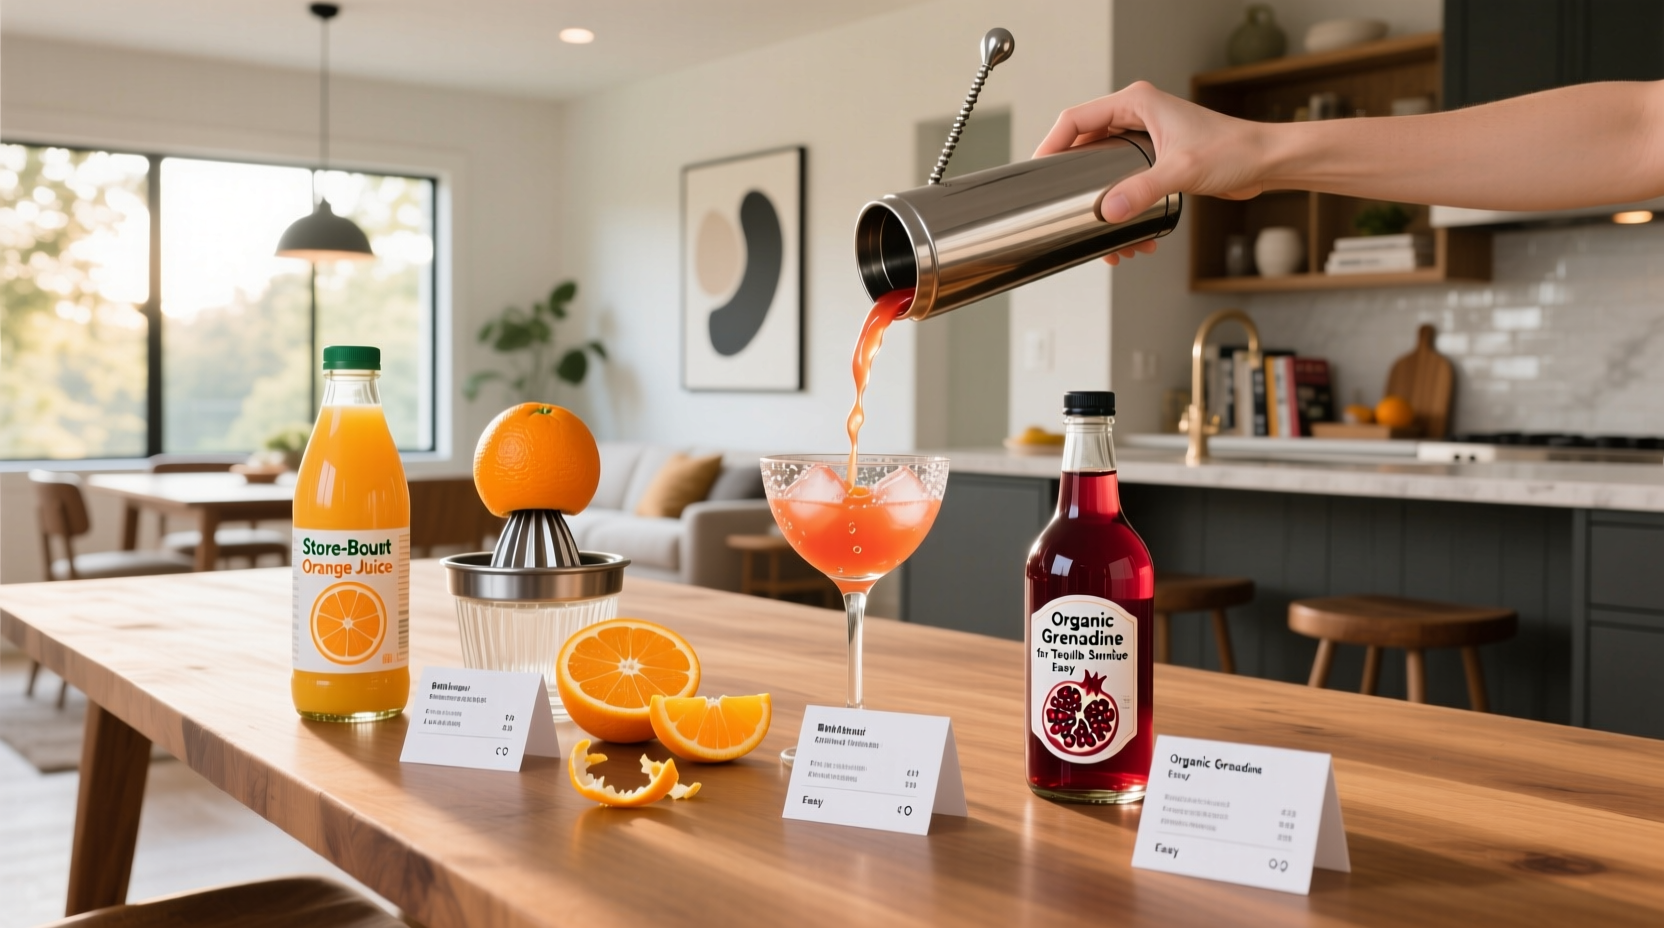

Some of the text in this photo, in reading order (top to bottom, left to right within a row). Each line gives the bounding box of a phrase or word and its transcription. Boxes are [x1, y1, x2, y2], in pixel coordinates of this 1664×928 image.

[302, 558, 393, 579] Orange Juice
[1051, 611, 1114, 631] Organic
[1042, 628, 1124, 646] Grenadine
[1052, 662, 1076, 676] Easy
[1170, 753, 1211, 769] Organic
